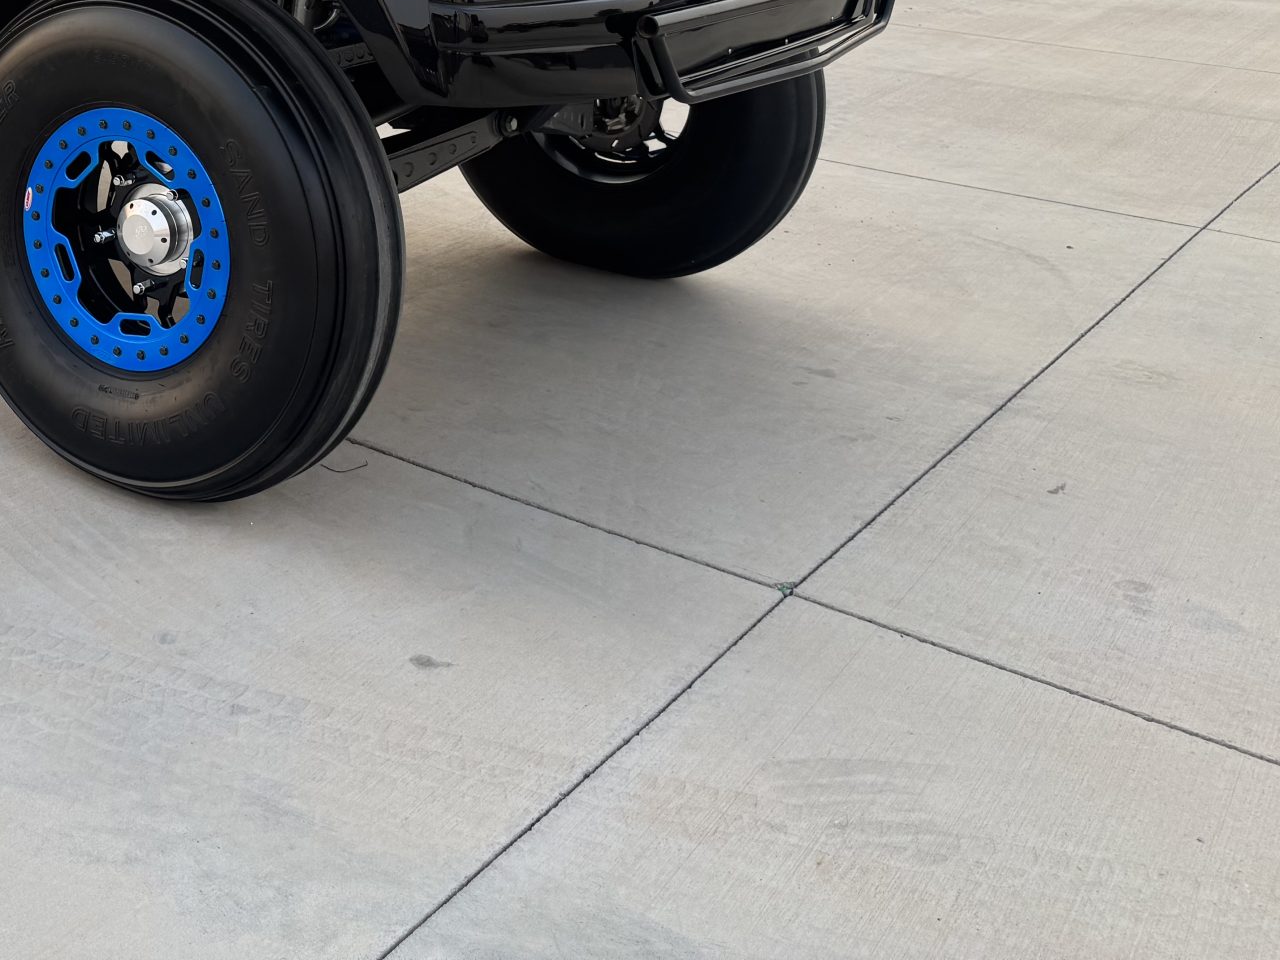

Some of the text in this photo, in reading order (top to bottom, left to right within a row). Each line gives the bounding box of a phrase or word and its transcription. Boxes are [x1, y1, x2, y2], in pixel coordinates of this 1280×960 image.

[223, 138, 272, 247] SAND
[231, 279, 275, 385] TIRES
[70, 391, 227, 448] UNLIMITED
